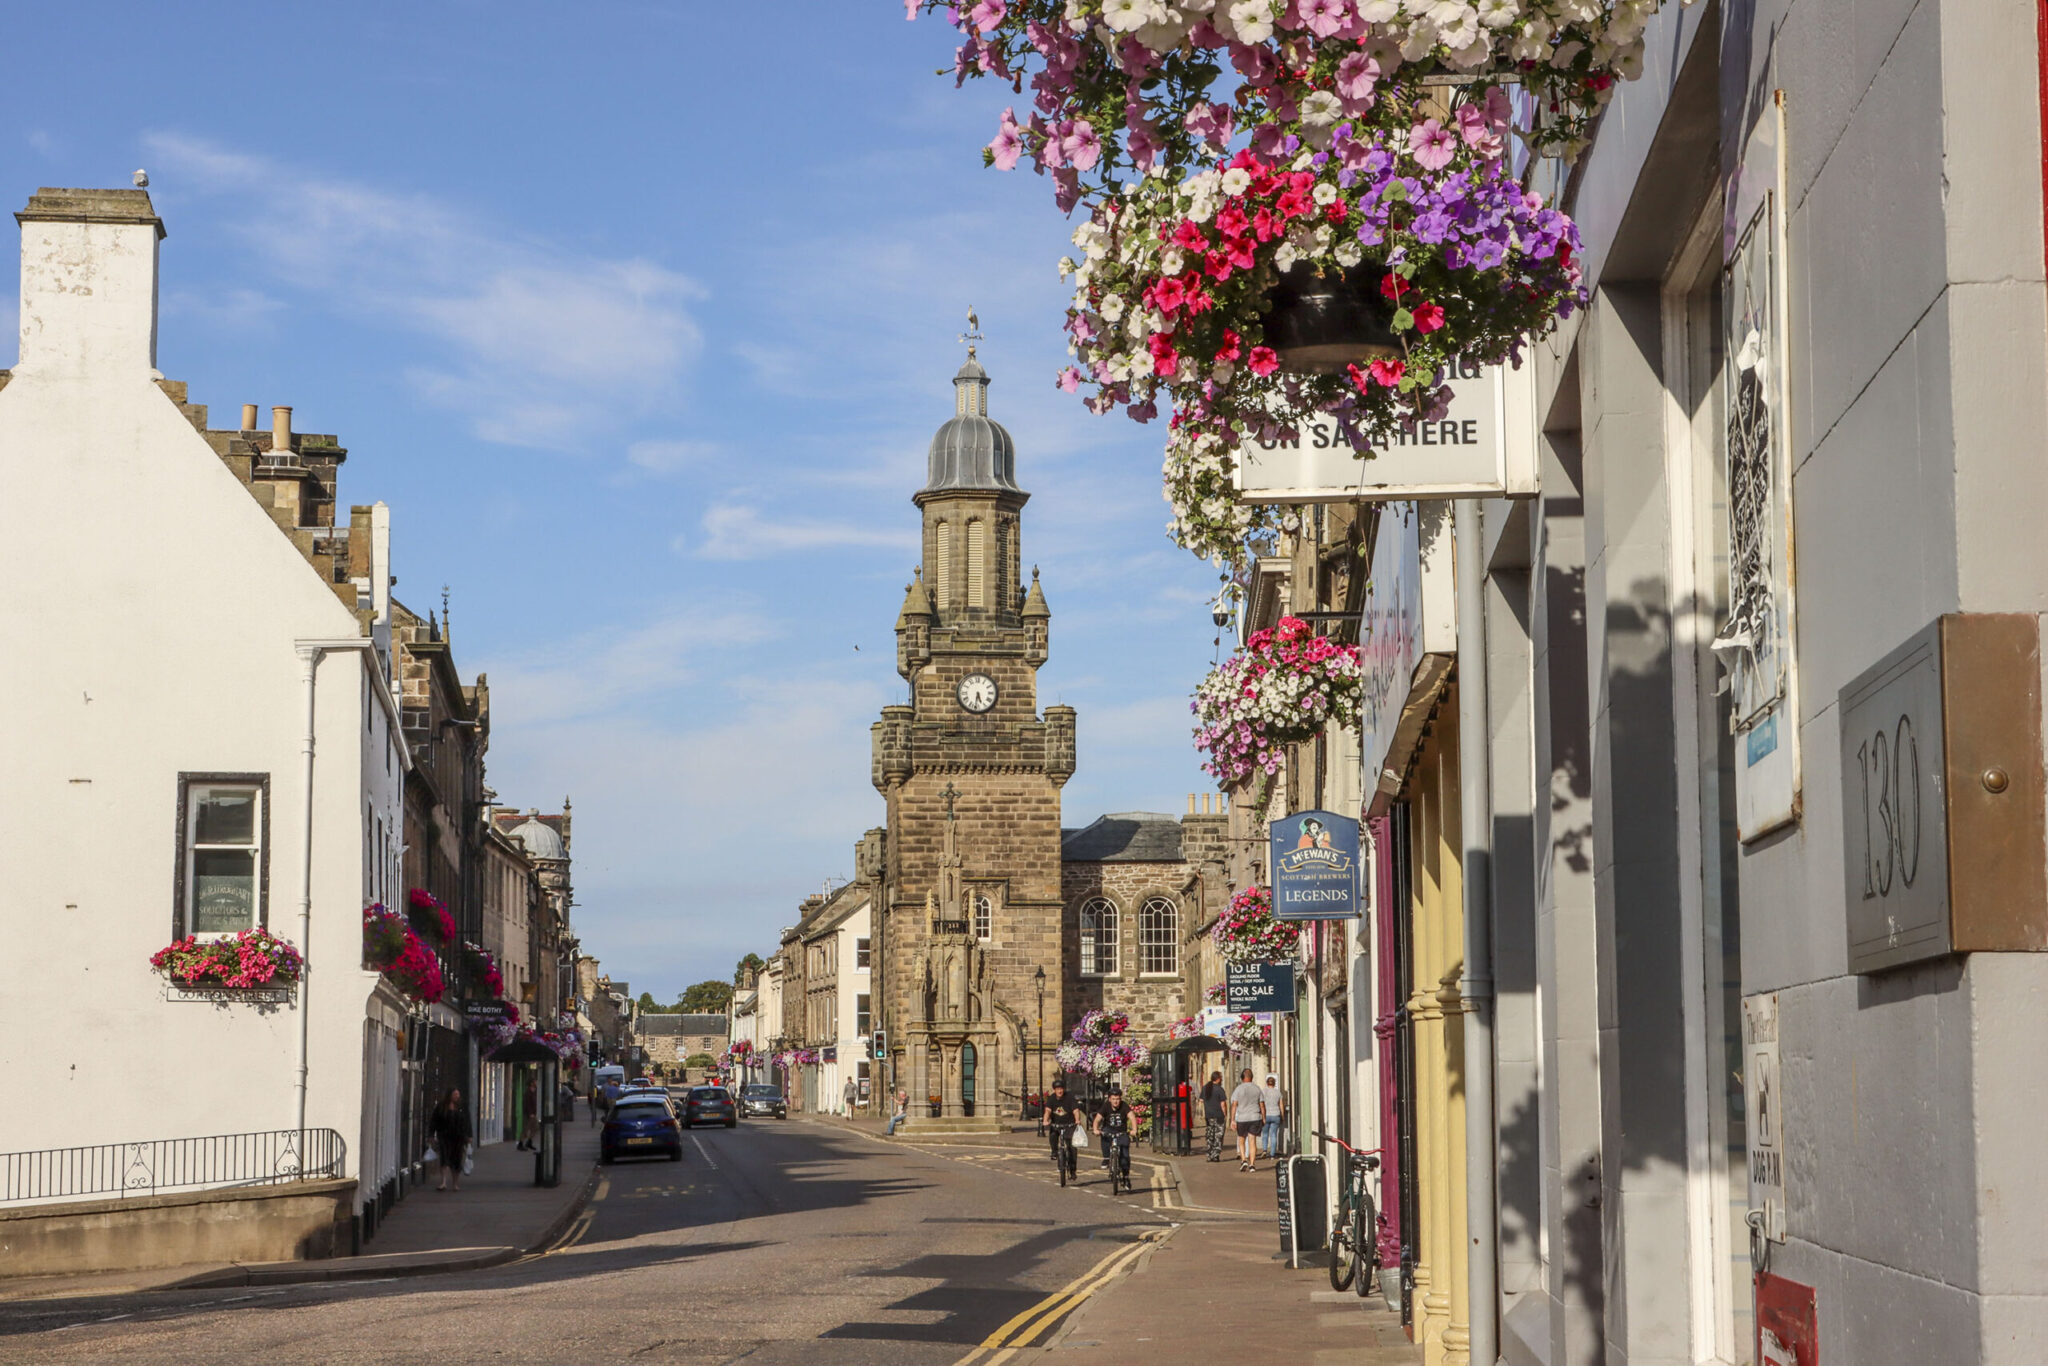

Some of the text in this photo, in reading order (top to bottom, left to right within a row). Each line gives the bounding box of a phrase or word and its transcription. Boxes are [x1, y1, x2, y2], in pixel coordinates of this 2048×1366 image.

[1312, 421, 1387, 449] SAE
[1400, 420, 1478, 446] HERE
[1857, 714, 1920, 900] 130
[1285, 889, 1349, 902] LEGENDS
[1230, 963, 1261, 974] TO LET
[1230, 985, 1274, 996] FOR SALE
[1752, 1150, 1782, 1187] DOG PRK
